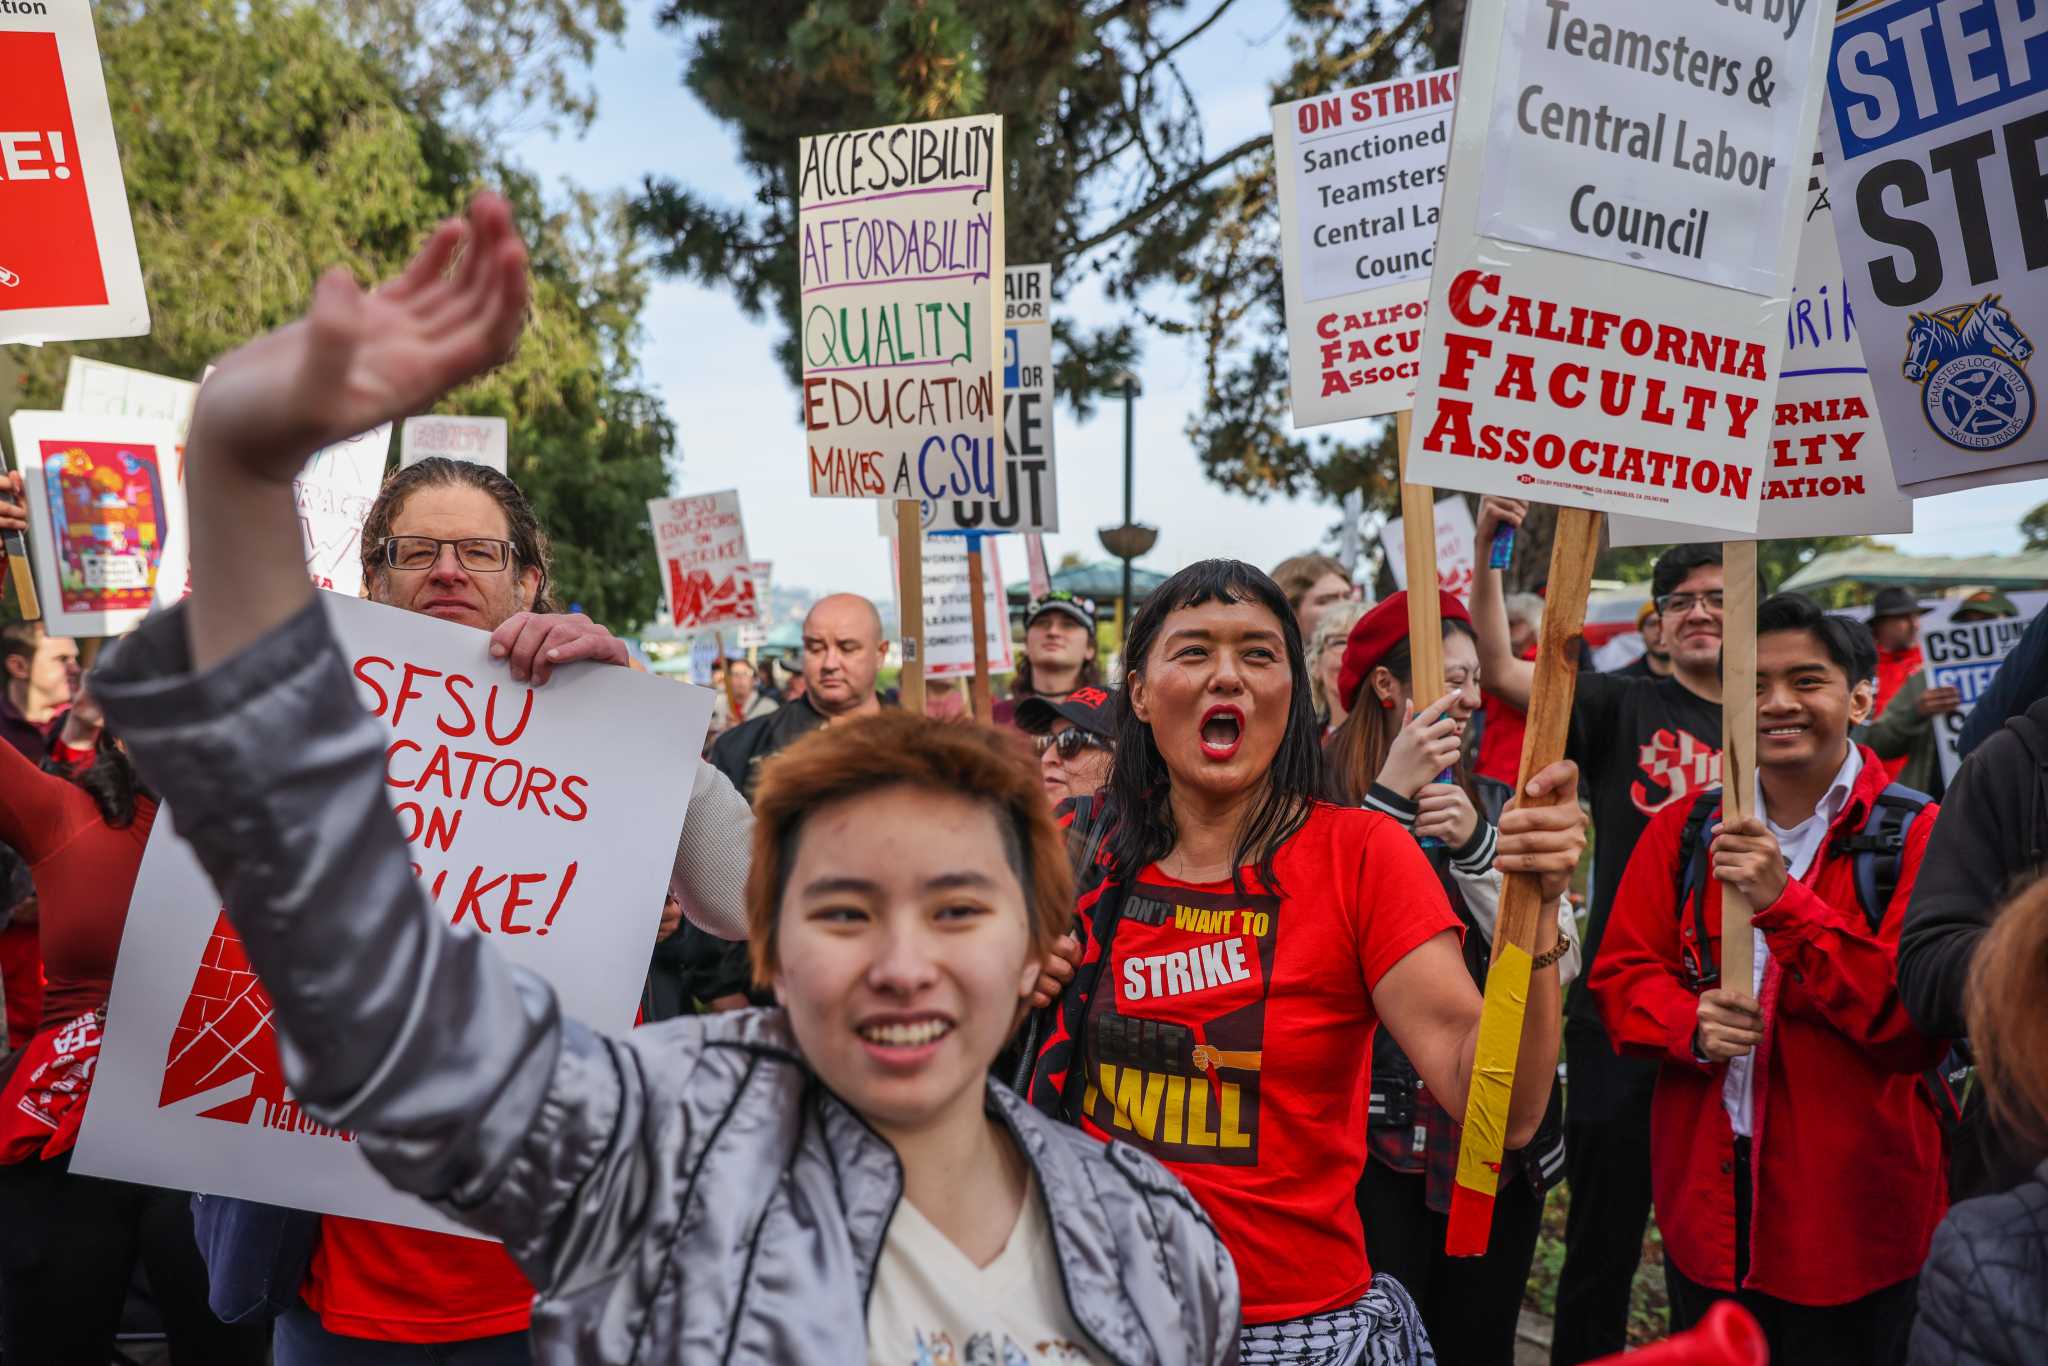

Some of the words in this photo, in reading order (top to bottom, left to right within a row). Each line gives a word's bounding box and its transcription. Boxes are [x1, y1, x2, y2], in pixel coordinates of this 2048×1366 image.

[1545, 0, 1742, 98] Teamsters
[1747, 55, 1775, 108] &
[1298, 97, 1342, 134] ON
[1350, 71, 1459, 122] STRIK
[0, 131, 72, 181] E!
[801, 125, 994, 205] ACCESSIBILITY
[1304, 120, 1446, 174] Sanctioned
[1517, 85, 1667, 163] Central
[1673, 120, 1775, 190] Labor
[1318, 164, 1446, 208] Teamsters
[802, 212, 992, 286] AFFORDABILITY
[1313, 207, 1404, 248] Central
[1569, 184, 1709, 259] Council
[806, 302, 972, 367] QUALITY
[1448, 269, 1767, 381] CALIFORNIA
[804, 371, 993, 431] EDUCATION
[1022, 366, 1043, 388] OR
[1439, 333, 1759, 439] FACULTY
[1930, 359, 1966, 409] TEAMSTERS
[1967, 357, 2002, 372] LOCAL
[2003, 368, 2025, 393] 2010
[1423, 398, 1753, 500] ASSOCIATION
[1948, 426, 1990, 447] SKILLED
[1992, 416, 2024, 445] TRADES
[810, 446, 886, 498] MAKES
[893, 452, 912, 497] A
[918, 434, 995, 500] CSU
[1926, 625, 1993, 663] CSU
[353, 656, 534, 746] SFSU
[1175, 904, 1235, 935] WANT
[1241, 911, 1269, 937] TO
[1123, 938, 1251, 1001] STRIKE
[1100, 1063, 1251, 1148] WILL
